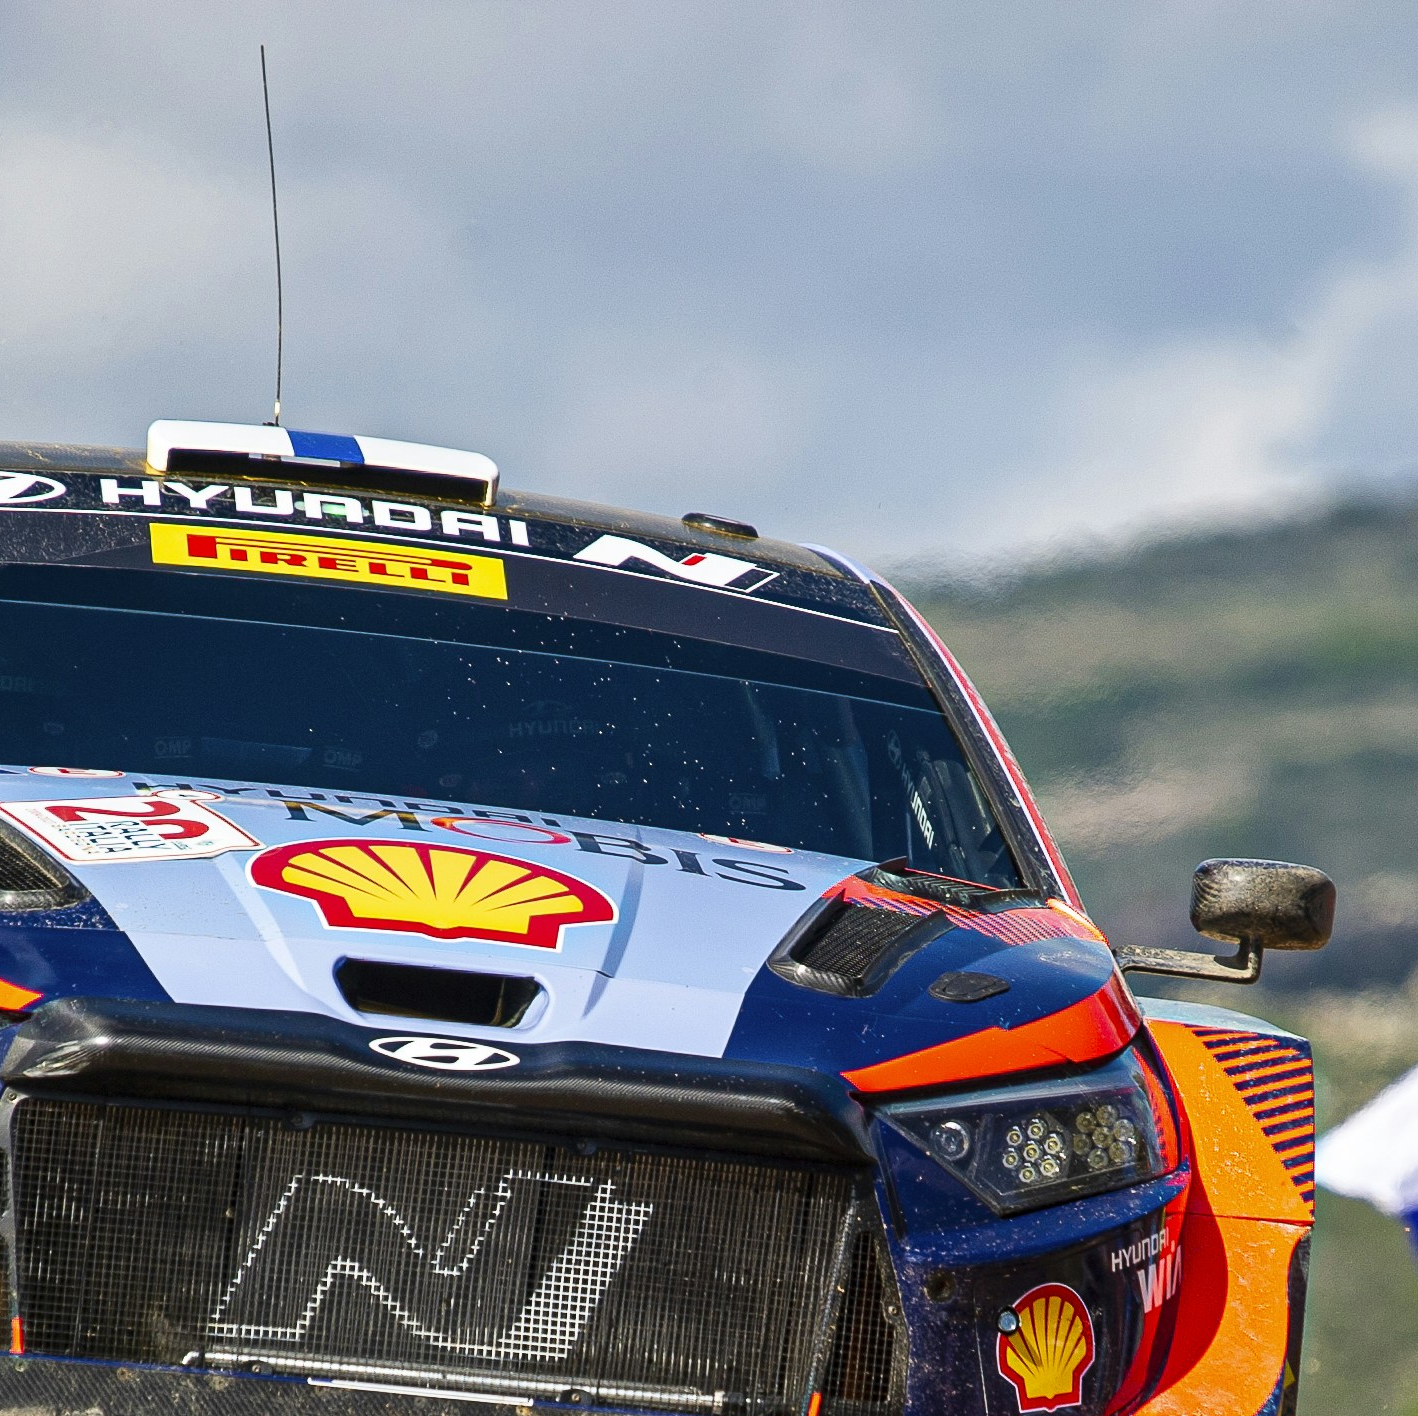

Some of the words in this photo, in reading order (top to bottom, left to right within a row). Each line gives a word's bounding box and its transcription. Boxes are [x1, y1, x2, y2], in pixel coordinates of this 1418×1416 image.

[99, 478, 531, 546] HYUNDAI
[187, 533, 473, 587] PIRELLI
[133, 782, 562, 828] HYUNDAI
[68, 822, 133, 854] ITALIA
[105, 820, 173, 851] RALLY
[280, 799, 807, 892] MOBIS
[1110, 1226, 1170, 1273] HYUNDAI
